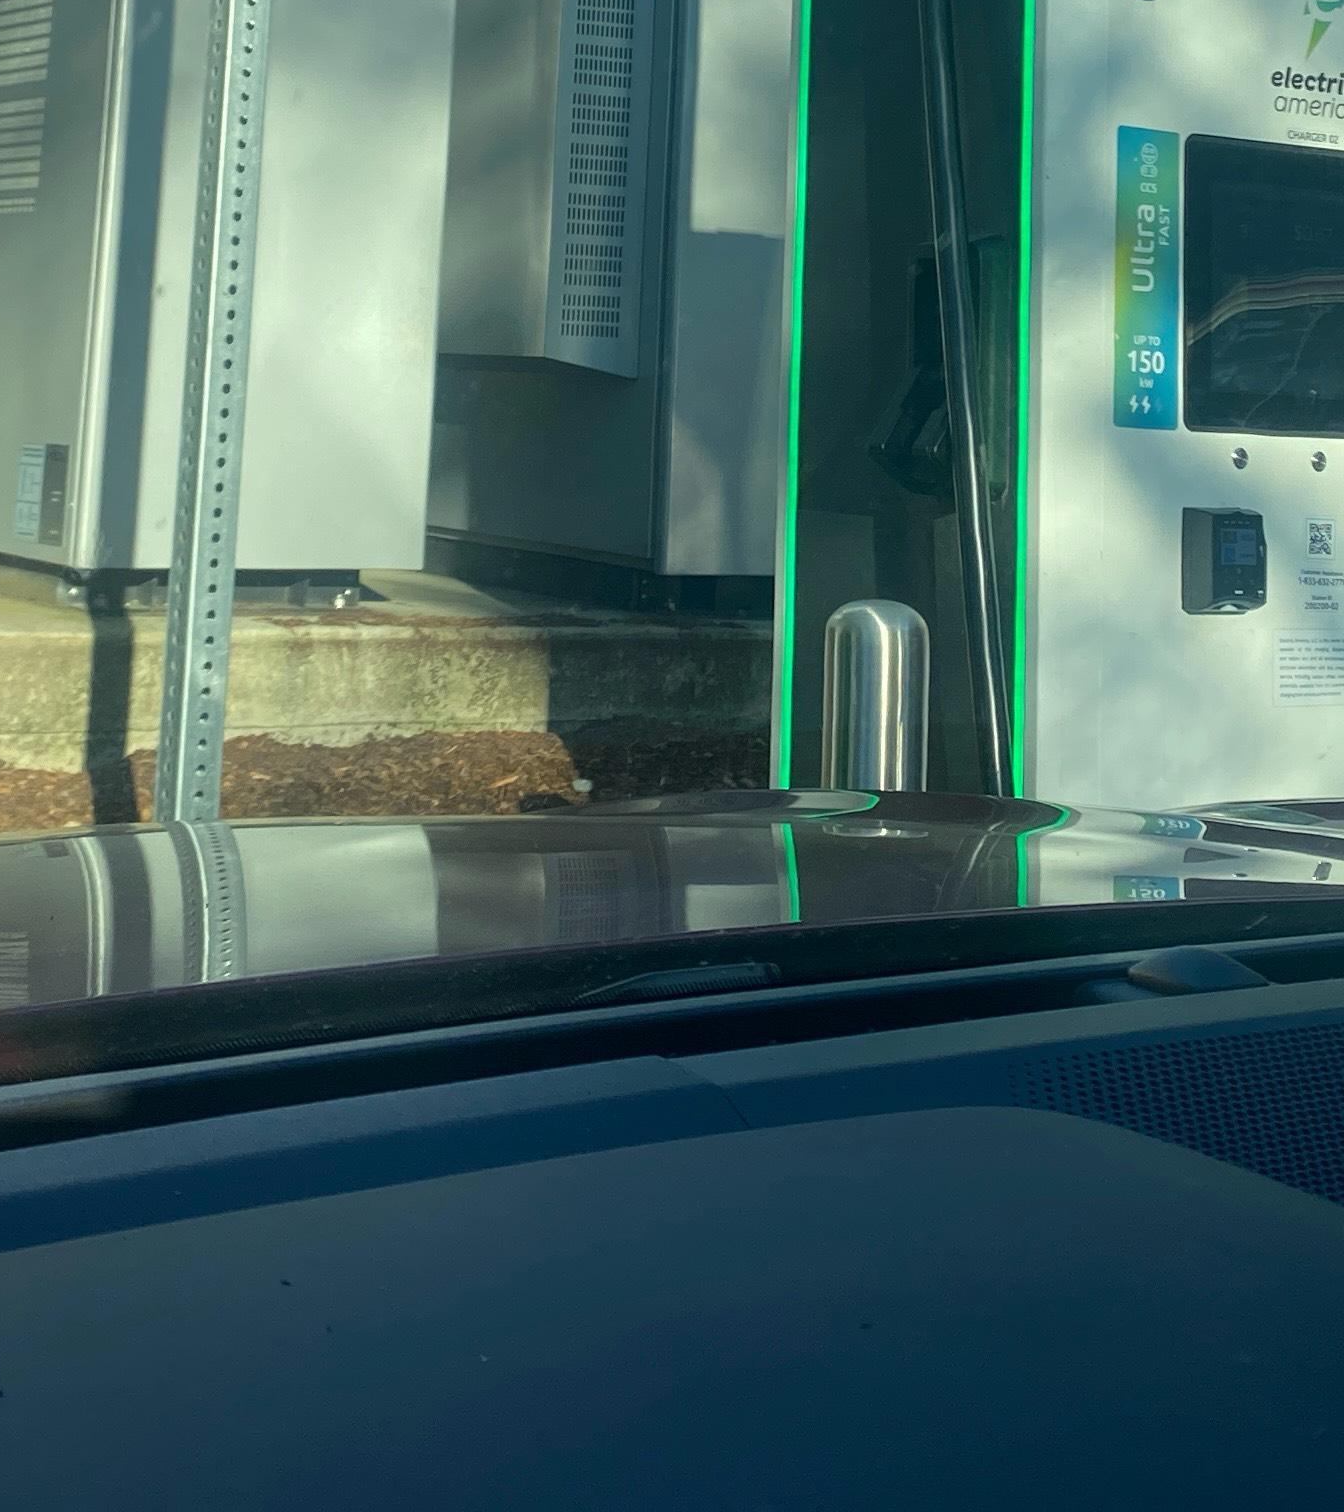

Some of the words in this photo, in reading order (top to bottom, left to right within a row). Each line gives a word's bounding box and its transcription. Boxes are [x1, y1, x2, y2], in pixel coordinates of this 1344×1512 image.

[1159, 205, 1171, 246] FAST
[1131, 203, 1155, 292] Ultra
[1134, 335, 1147, 346] UP
[1148, 336, 1161, 346] TO
[1127, 349, 1166, 375] 150
